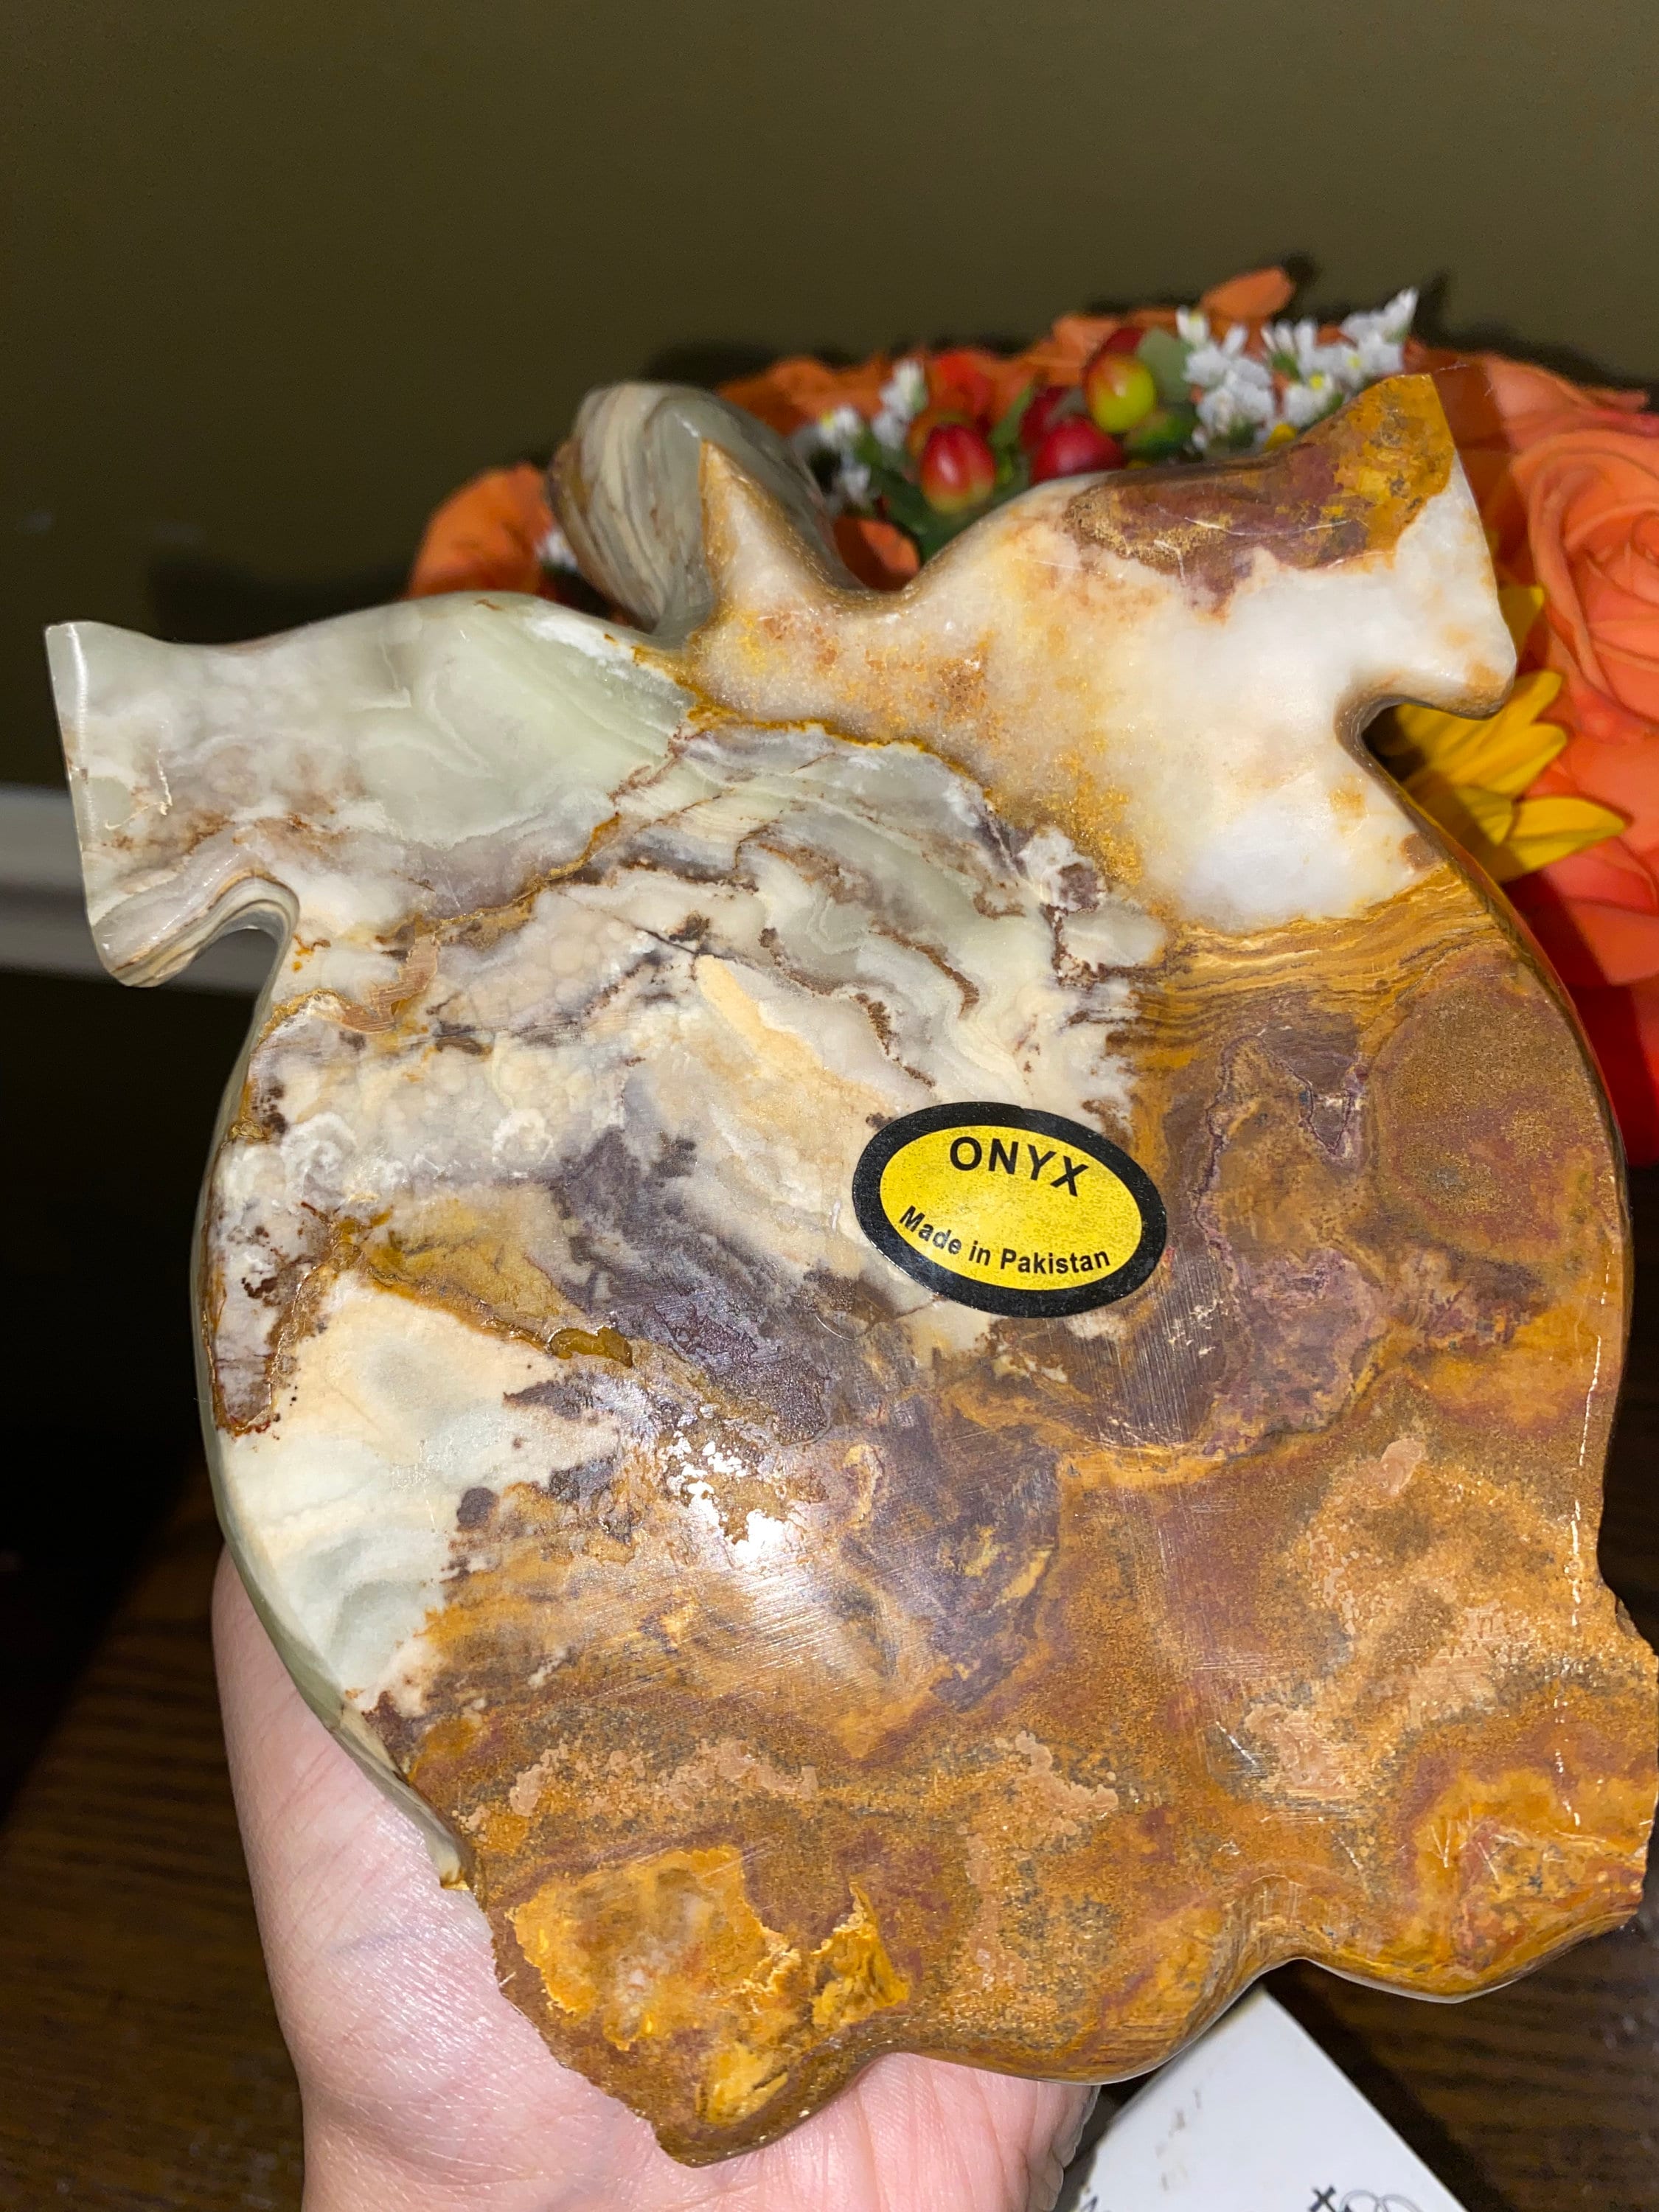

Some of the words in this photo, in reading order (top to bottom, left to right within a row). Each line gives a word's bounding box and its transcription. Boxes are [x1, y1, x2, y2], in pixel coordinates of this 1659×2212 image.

[950, 1136, 1088, 1197] ONYX
[900, 1206, 961, 1254] Made
[968, 1240, 990, 1266] in
[1000, 1248, 1110, 1274] Pakistan
